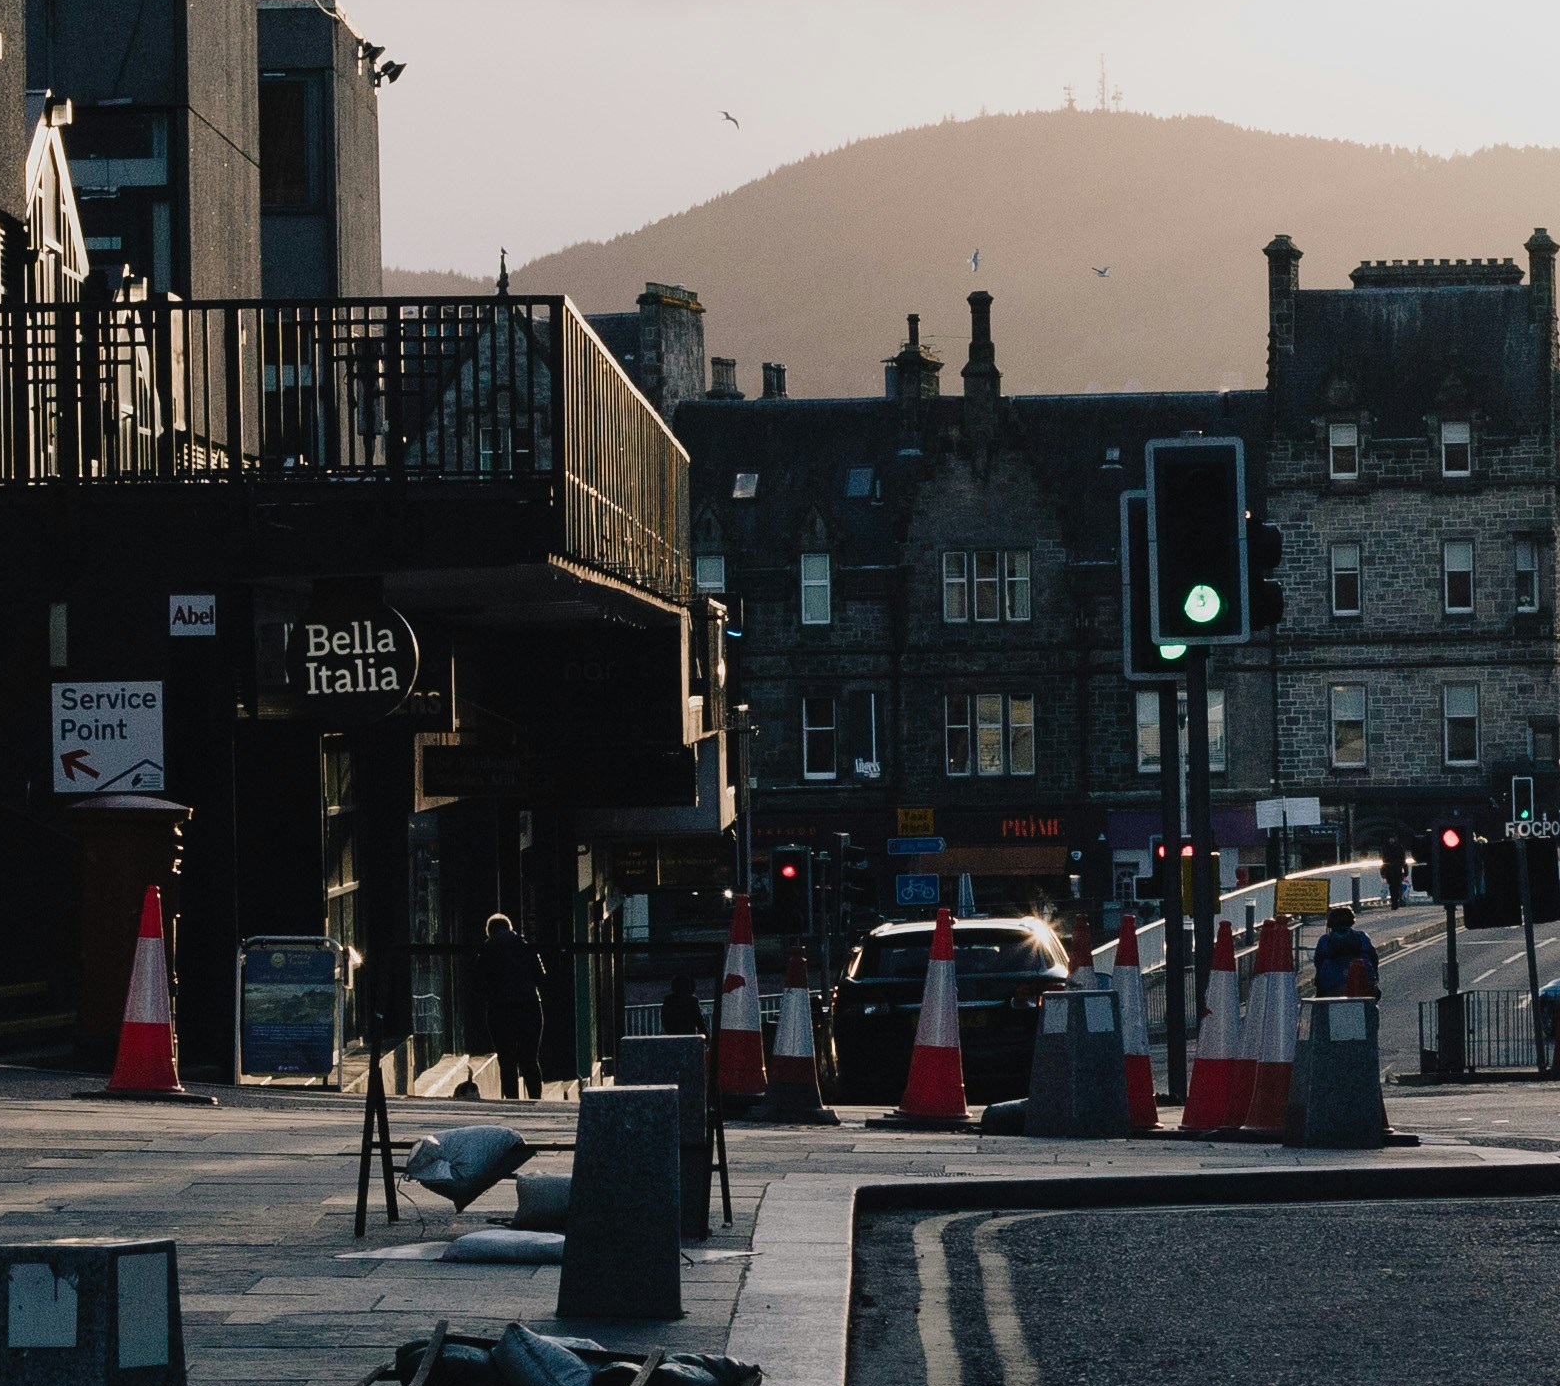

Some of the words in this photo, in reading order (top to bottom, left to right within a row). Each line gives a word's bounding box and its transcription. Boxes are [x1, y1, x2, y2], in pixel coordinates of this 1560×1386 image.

[172, 605, 214, 626] Abel
[305, 620, 397, 658] Bella
[305, 661, 401, 695] Italia
[60, 687, 157, 711] Service
[60, 719, 128, 741] Point
[904, 810, 928, 821] Taxi
[901, 822, 930, 833] Rank
